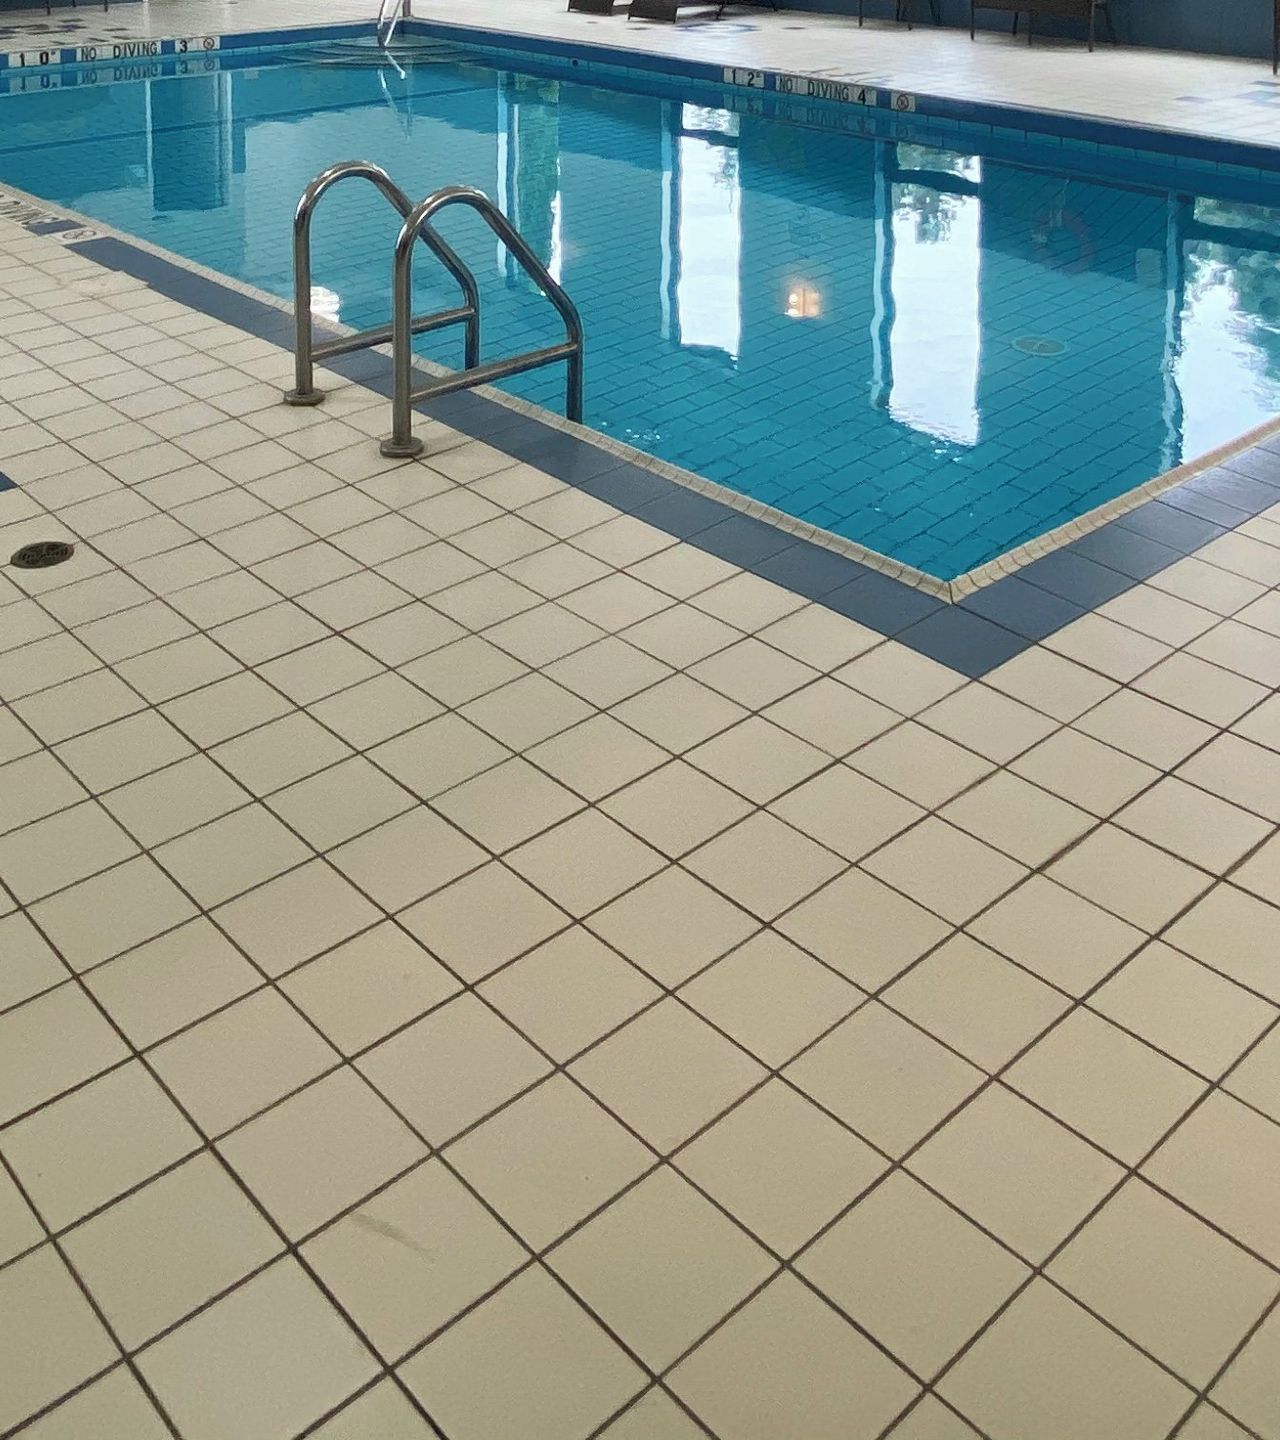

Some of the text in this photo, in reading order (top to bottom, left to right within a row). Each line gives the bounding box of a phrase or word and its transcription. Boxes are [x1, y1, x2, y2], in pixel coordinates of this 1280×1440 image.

[81, 47, 97, 62] NO
[113, 41, 158, 59] DIVING
[778, 76, 794, 92] NO
[807, 81, 850, 101] DIVING
